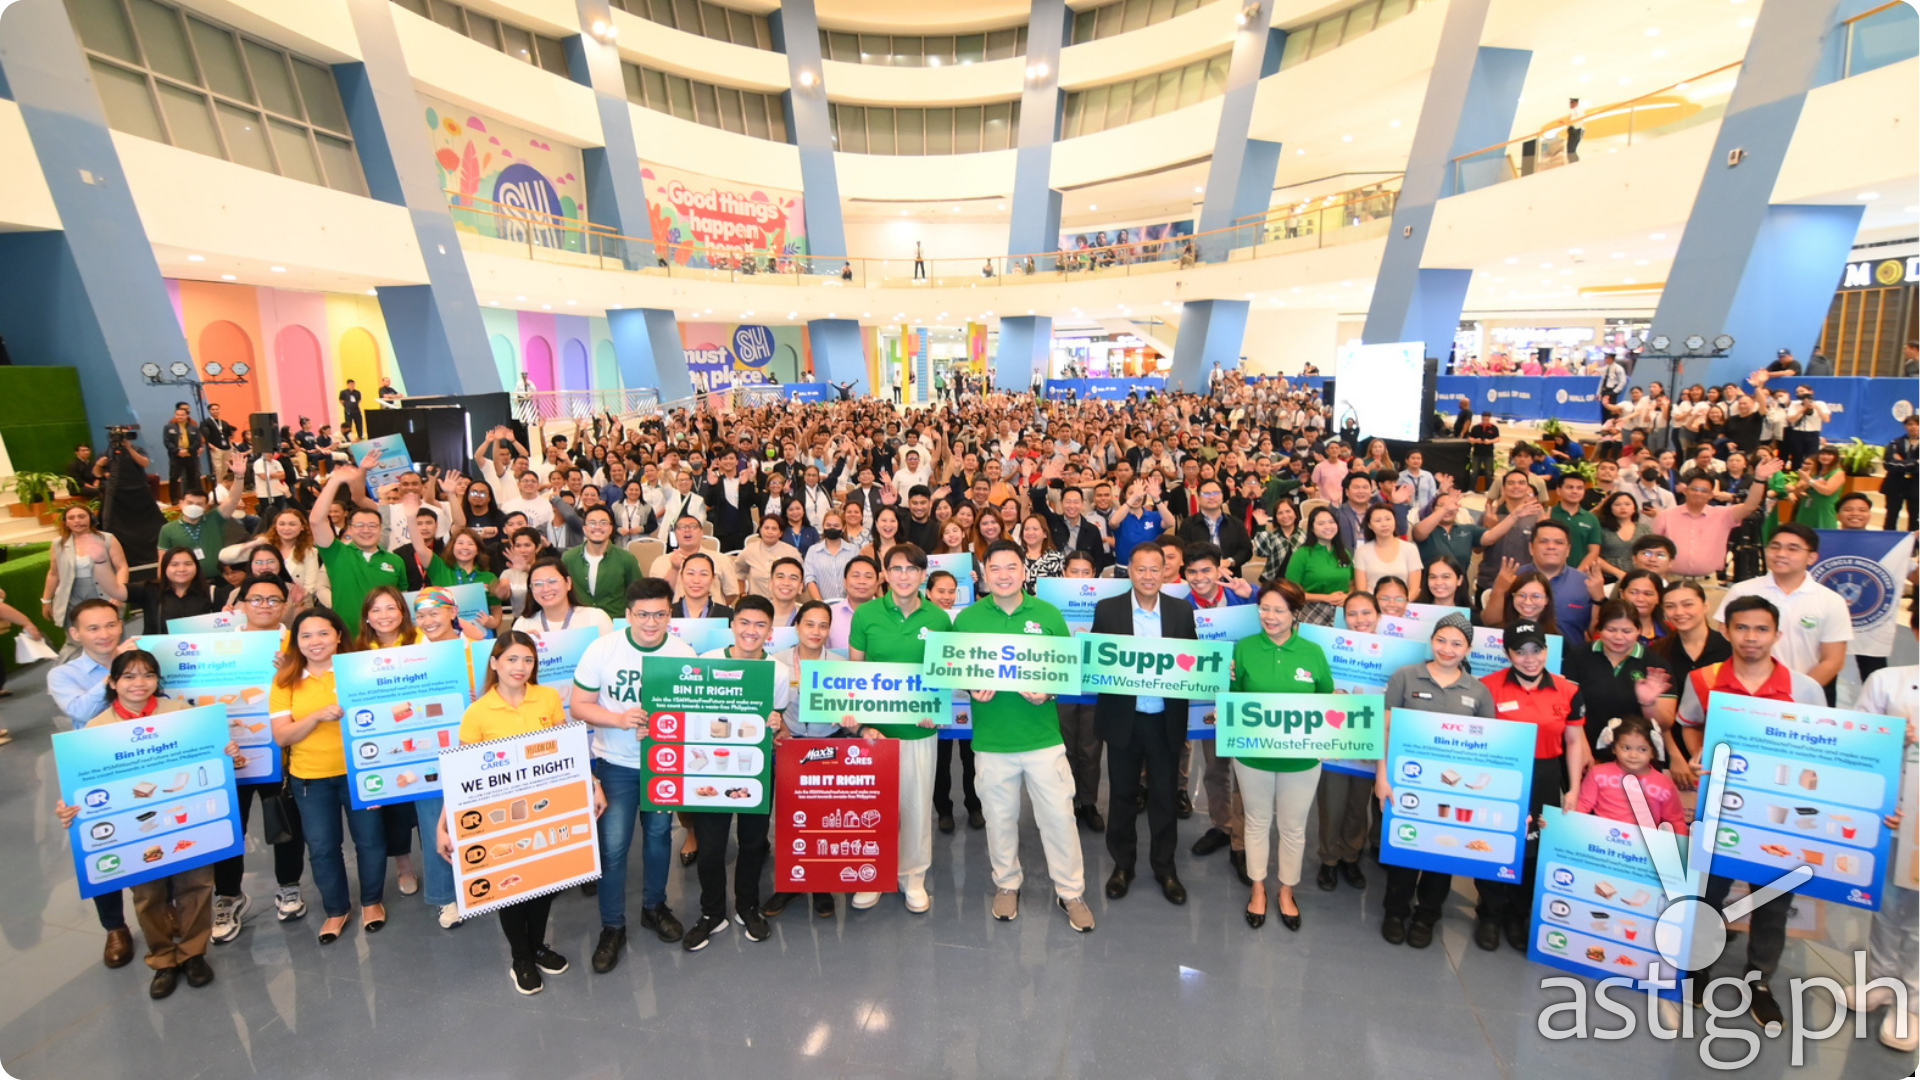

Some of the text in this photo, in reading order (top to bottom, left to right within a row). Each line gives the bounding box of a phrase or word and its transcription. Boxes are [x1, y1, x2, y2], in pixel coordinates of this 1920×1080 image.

[668, 182, 778, 223] Good things
[689, 209, 759, 240] happen
[1205, 631, 1227, 640] right!
[1516, 624, 1536, 633] KFC
[942, 645, 1078, 664] Be the Solution
[1082, 641, 1092, 664] I
[1332, 643, 1354, 652] CARES
[1470, 651, 1485, 659] Bin
[1486, 652, 1493, 660] it
[178, 660, 237, 671] Bin it right!
[1332, 655, 1382, 670] Bin it right!
[376, 672, 428, 686] Bin it right!
[616, 669, 642, 686] SP
[926, 661, 1069, 682] Join the Mission
[812, 671, 940, 692] I care for th
[1082, 673, 1220, 693] #SMWasteFreeFuture
[608, 684, 642, 702] HA
[673, 685, 743, 696] BIN IT RIGHT!
[809, 692, 942, 713] Environment
[1226, 701, 1234, 727] I
[1441, 723, 1463, 731] KFC
[1226, 737, 1375, 751] #SMWasteFreeFuture
[1434, 736, 1488, 750] Bin it right!
[1764, 726, 1838, 746] Bin it right!
[115, 741, 178, 761] Bin it right!
[481, 758, 510, 771] CARES
[845, 757, 873, 765] CARES
[461, 757, 575, 794] WE BIN IT RIGHT!
[800, 775, 876, 786] BIN IT RIGHT!
[1605, 836, 1633, 846] CARES
[1588, 843, 1606, 855] Bin
[1607, 848, 1616, 857] it
[1617, 852, 1647, 864] right!
